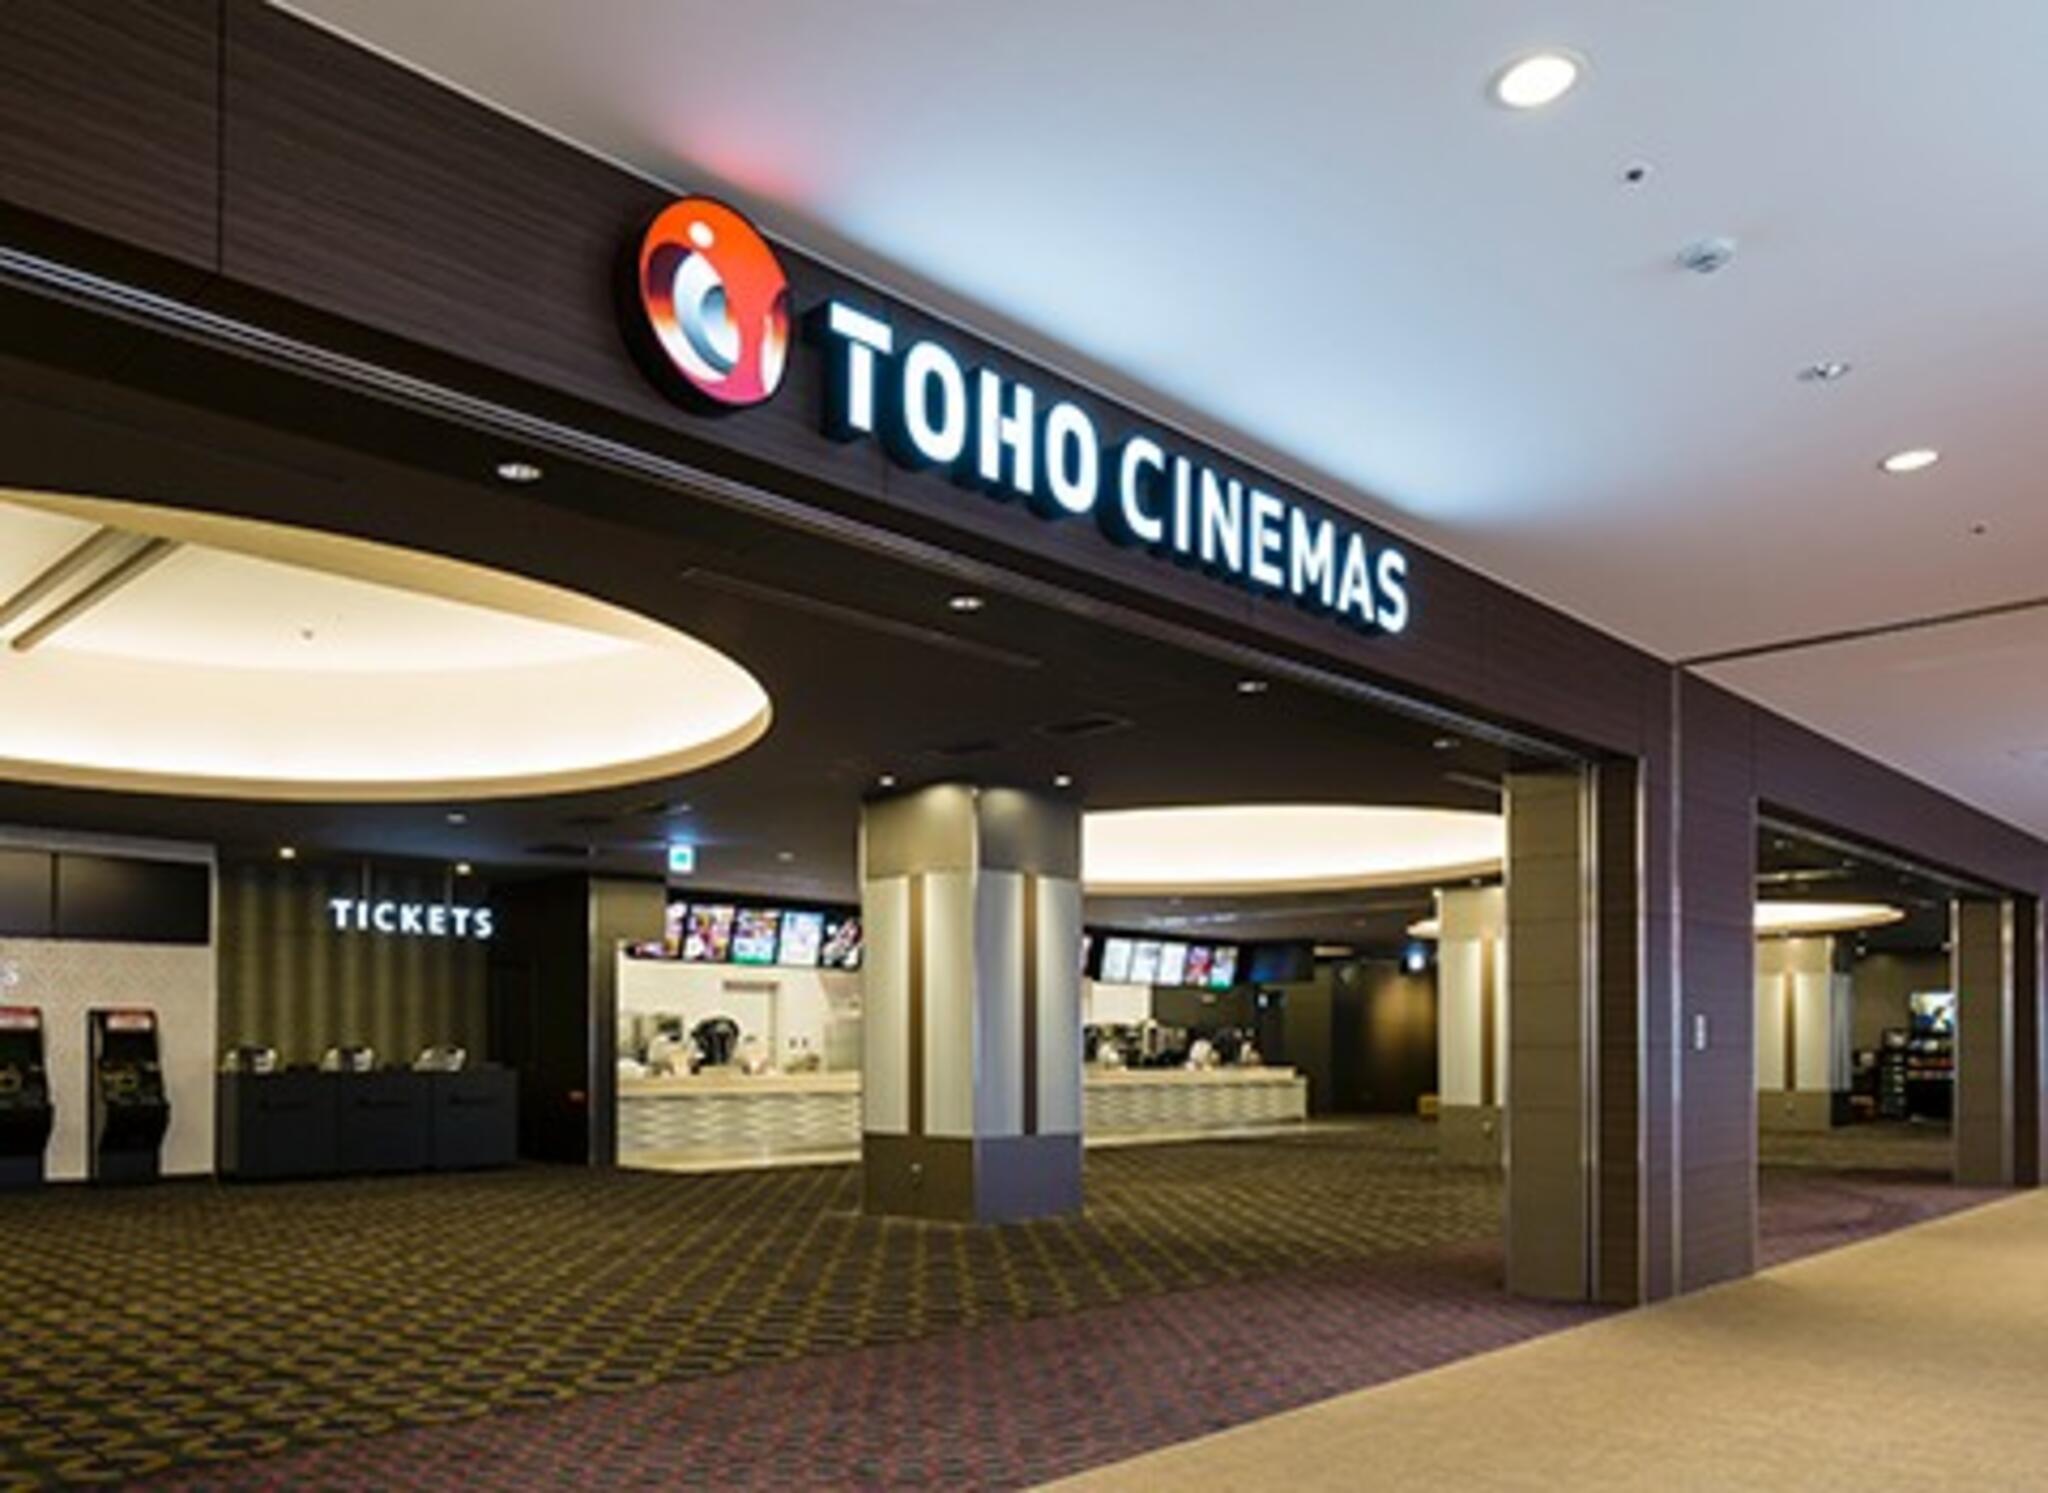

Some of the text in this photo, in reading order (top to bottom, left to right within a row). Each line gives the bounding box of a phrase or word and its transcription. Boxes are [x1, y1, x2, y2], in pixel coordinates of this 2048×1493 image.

[829, 301, 1409, 634] TOHO CINEMAS
[329, 898, 493, 938] TICKETS
